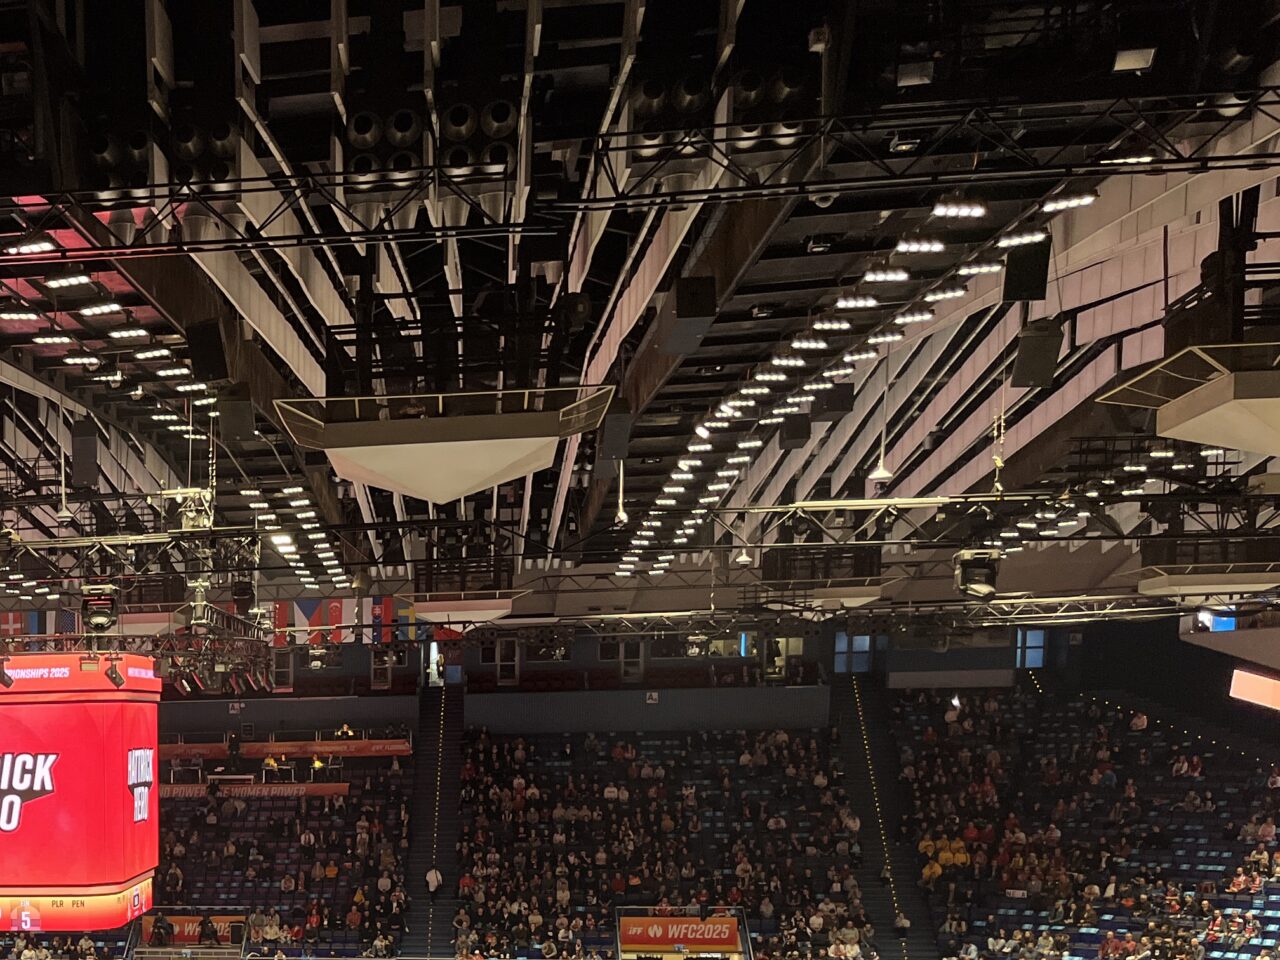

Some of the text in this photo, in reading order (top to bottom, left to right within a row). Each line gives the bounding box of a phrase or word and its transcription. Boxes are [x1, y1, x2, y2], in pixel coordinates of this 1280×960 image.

[50, 666, 70, 677] 2025
[233, 787, 267, 798] WOMEN
[269, 786, 307, 797] POWER
[51, 900, 84, 908] PLR PEN
[21, 911, 31, 929] 5
[667, 923, 730, 939] WFC2025
